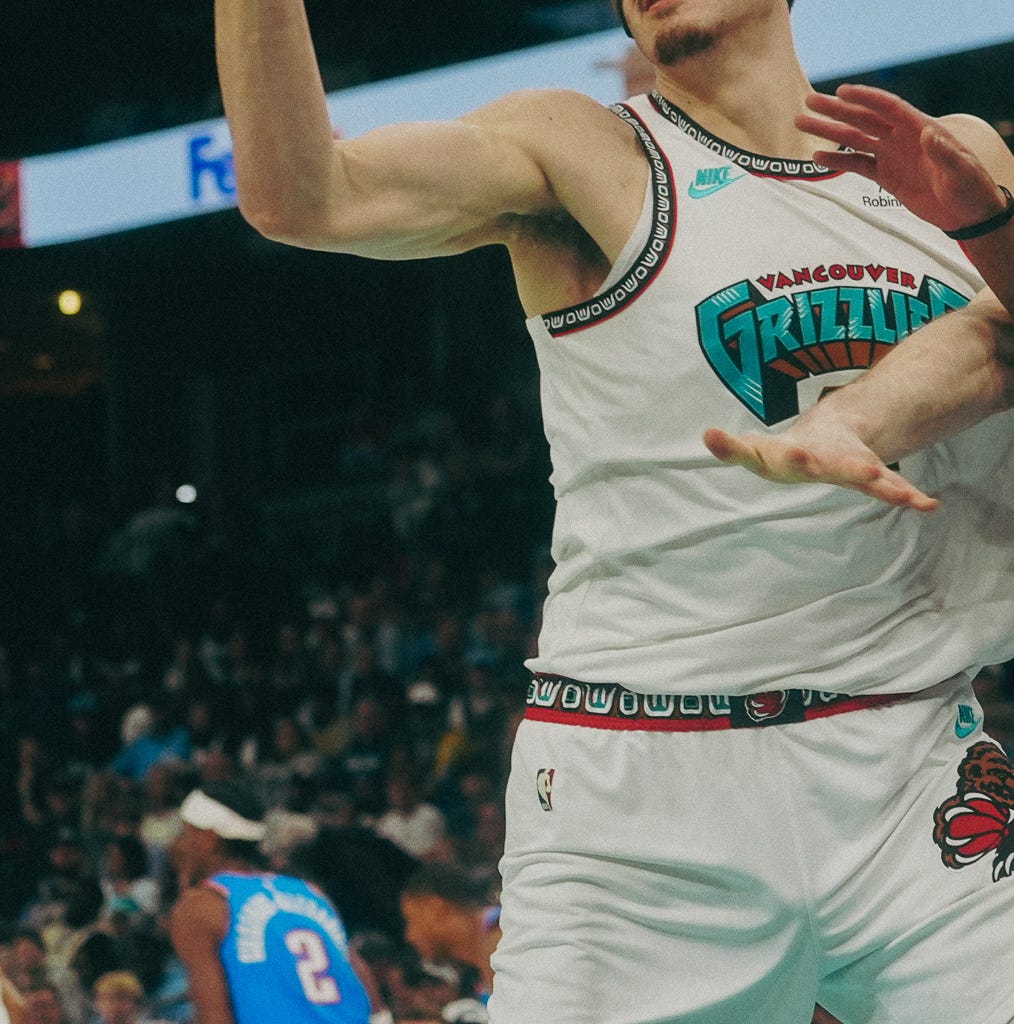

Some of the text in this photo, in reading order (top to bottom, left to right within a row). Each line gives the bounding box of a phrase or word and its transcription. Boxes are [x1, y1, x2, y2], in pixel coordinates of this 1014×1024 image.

[695, 166, 733, 186] NIKE
[756, 264, 917, 292] VANCOUVER
[285, 928, 341, 1005] 2
